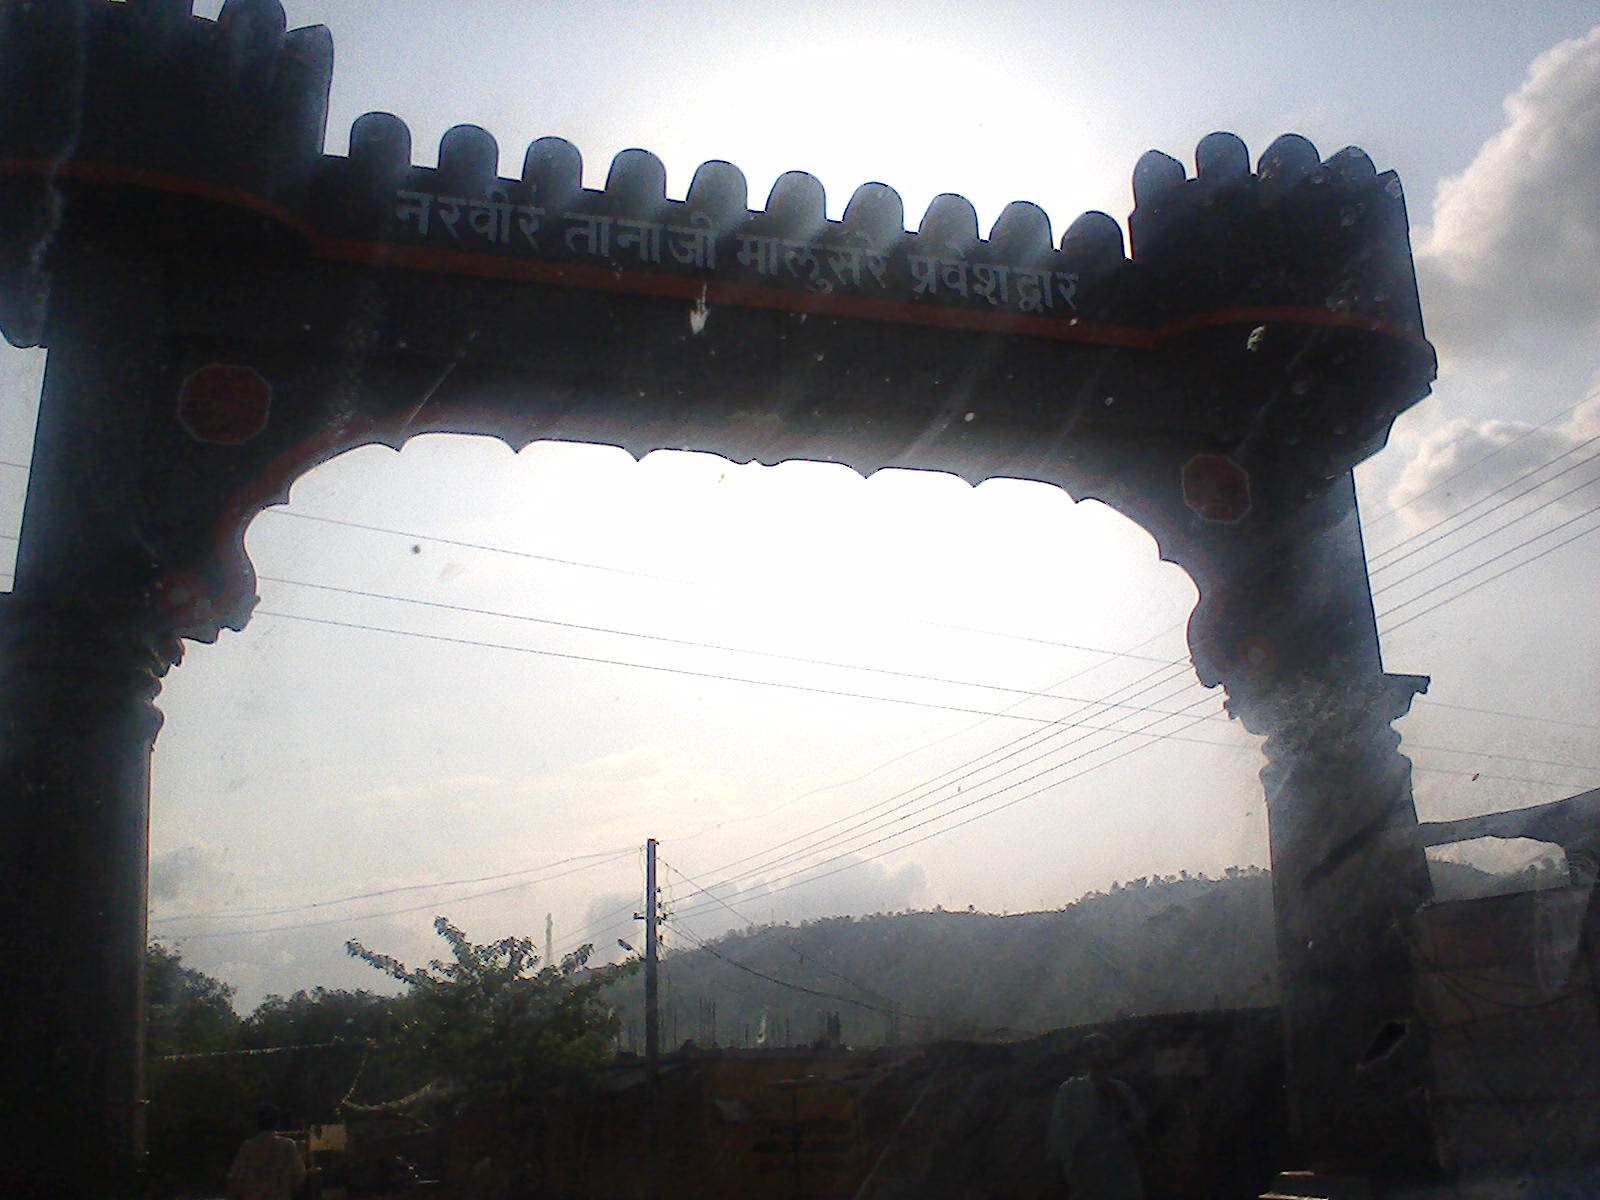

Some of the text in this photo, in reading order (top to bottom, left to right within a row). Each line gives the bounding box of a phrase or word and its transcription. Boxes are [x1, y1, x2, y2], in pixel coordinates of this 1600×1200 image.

[395, 184, 546, 249] नरवीर
[562, 211, 720, 270] तानाजी
[906, 241, 1080, 313] प्रवेशद्वार
